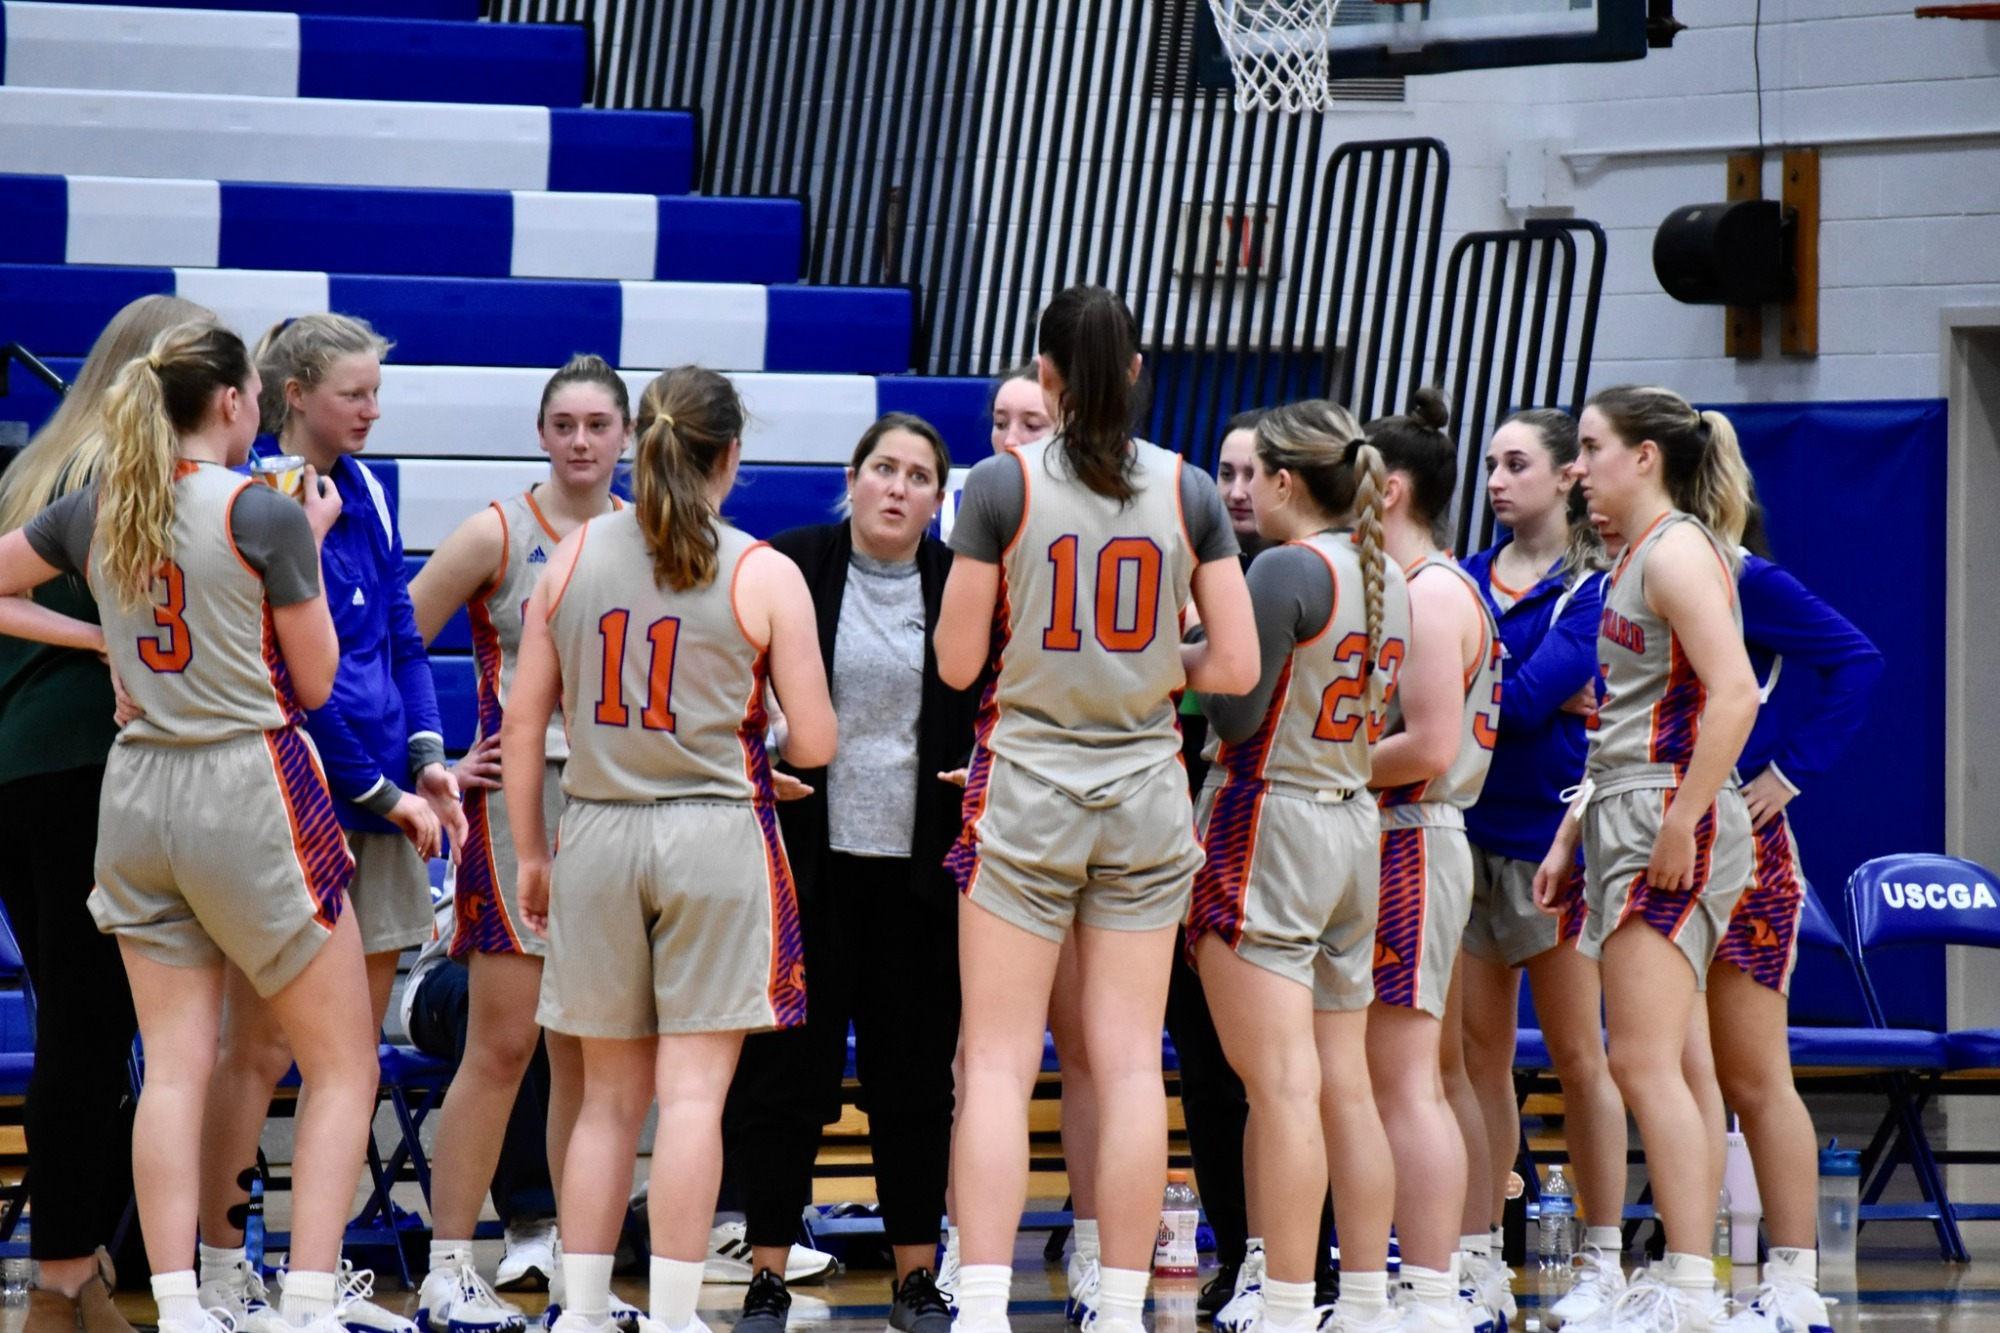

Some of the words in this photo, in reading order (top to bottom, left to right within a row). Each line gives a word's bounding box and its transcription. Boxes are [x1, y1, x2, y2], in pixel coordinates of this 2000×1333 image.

[137, 557, 193, 673] 3
[1042, 534, 1163, 653] 10
[595, 608, 681, 734] 11
[1881, 882, 1997, 910] USCGA
